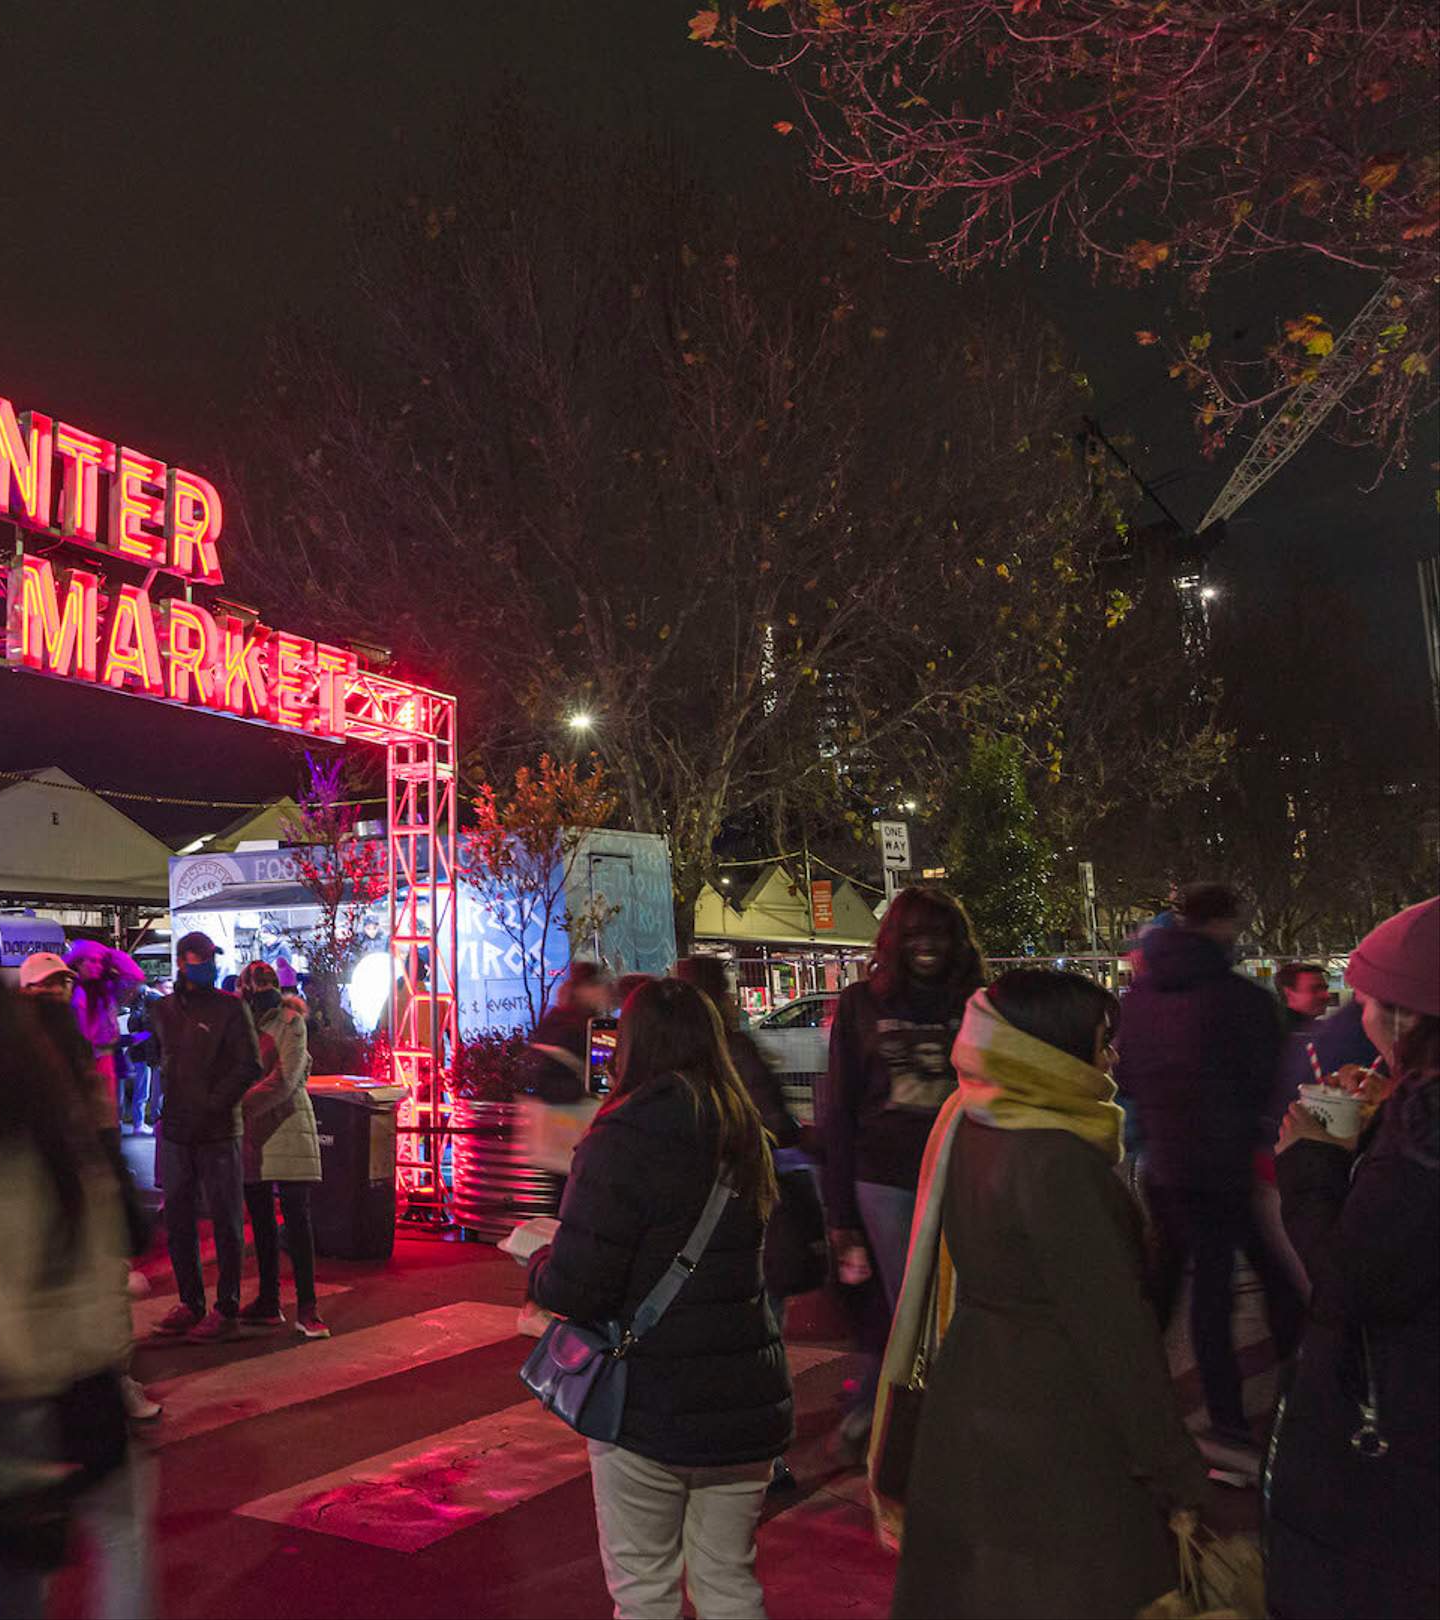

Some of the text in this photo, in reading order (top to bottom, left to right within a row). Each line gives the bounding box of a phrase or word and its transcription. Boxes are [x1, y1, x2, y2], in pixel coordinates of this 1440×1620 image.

[7, 552, 358, 742] MARKET
[51, 811, 60, 826] E
[885, 826, 905, 838] ONE
[885, 841, 906, 852] WAY
[255, 856, 305, 881] FOO
[191, 880, 219, 897] GREEK
[486, 995, 529, 1014] EVENTS
